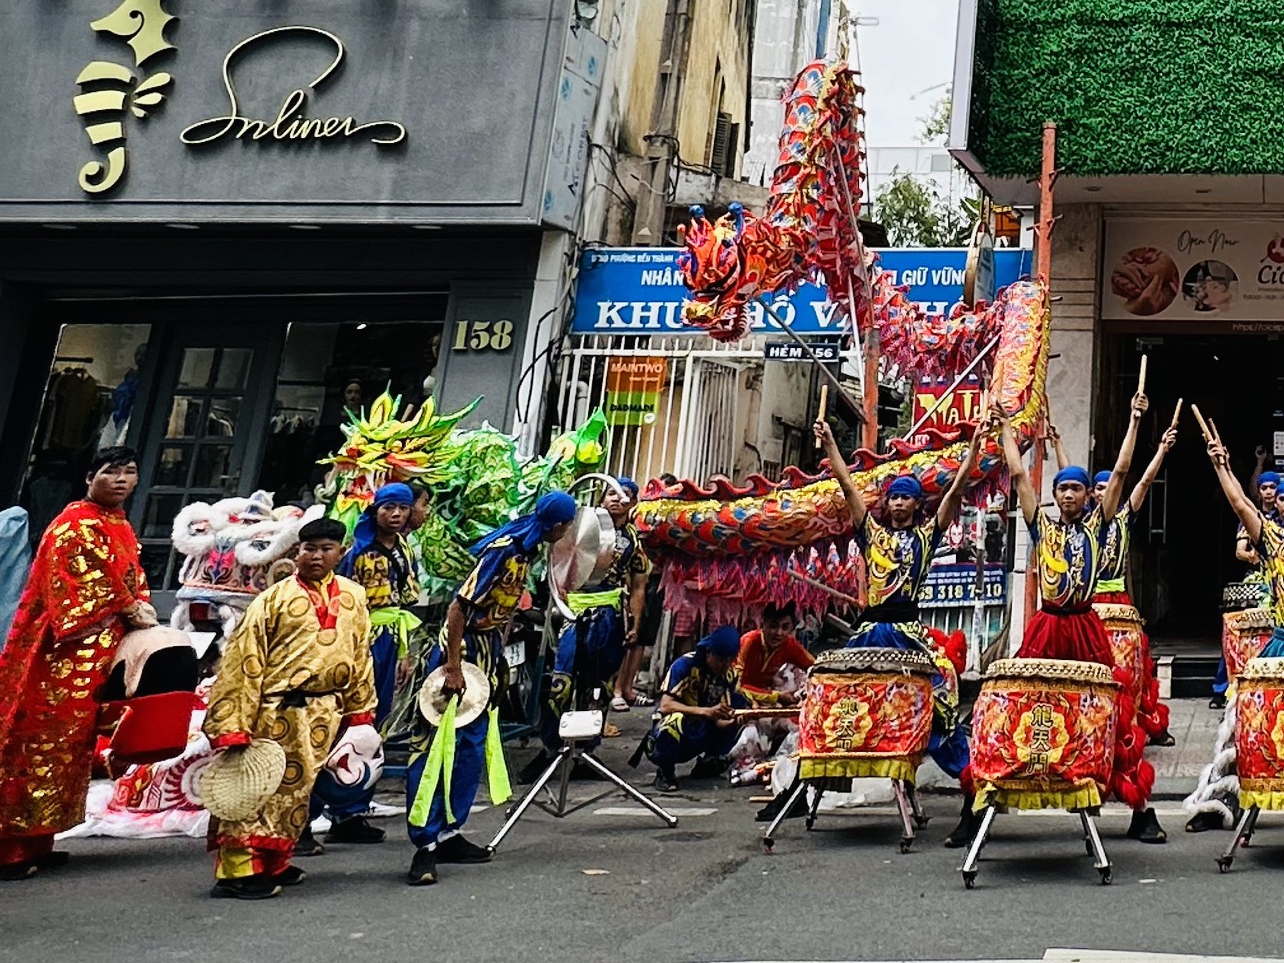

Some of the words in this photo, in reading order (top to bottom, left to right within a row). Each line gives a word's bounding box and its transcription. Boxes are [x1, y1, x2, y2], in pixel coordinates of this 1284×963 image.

[1177, 229, 1207, 255] Open
[902, 266, 929, 287] GIỮ
[938, 584, 964, 599] 318
